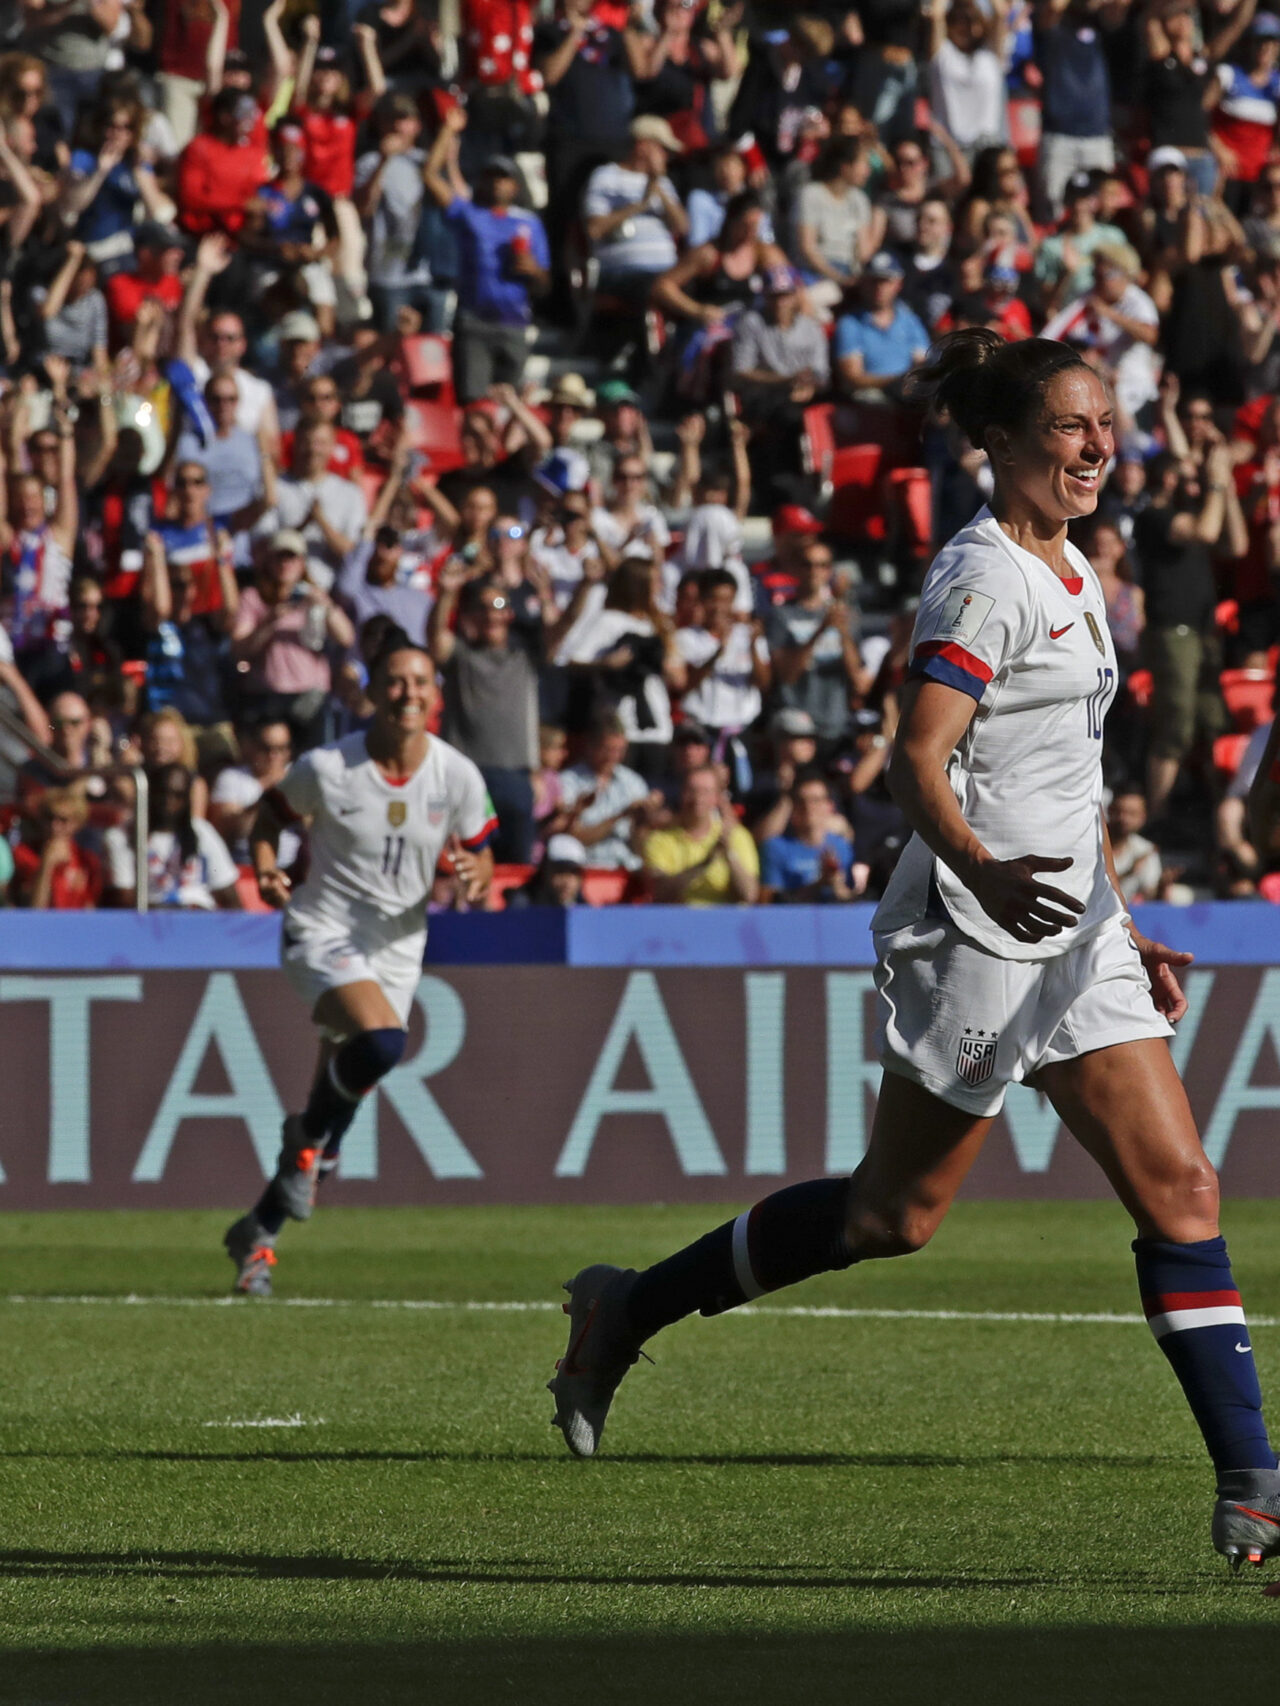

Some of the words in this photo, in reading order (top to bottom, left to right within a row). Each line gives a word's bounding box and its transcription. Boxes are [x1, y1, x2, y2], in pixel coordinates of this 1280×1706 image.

[1086, 667, 1113, 740] 10
[382, 836, 405, 876] 11
[963, 1041, 995, 1061] USA
